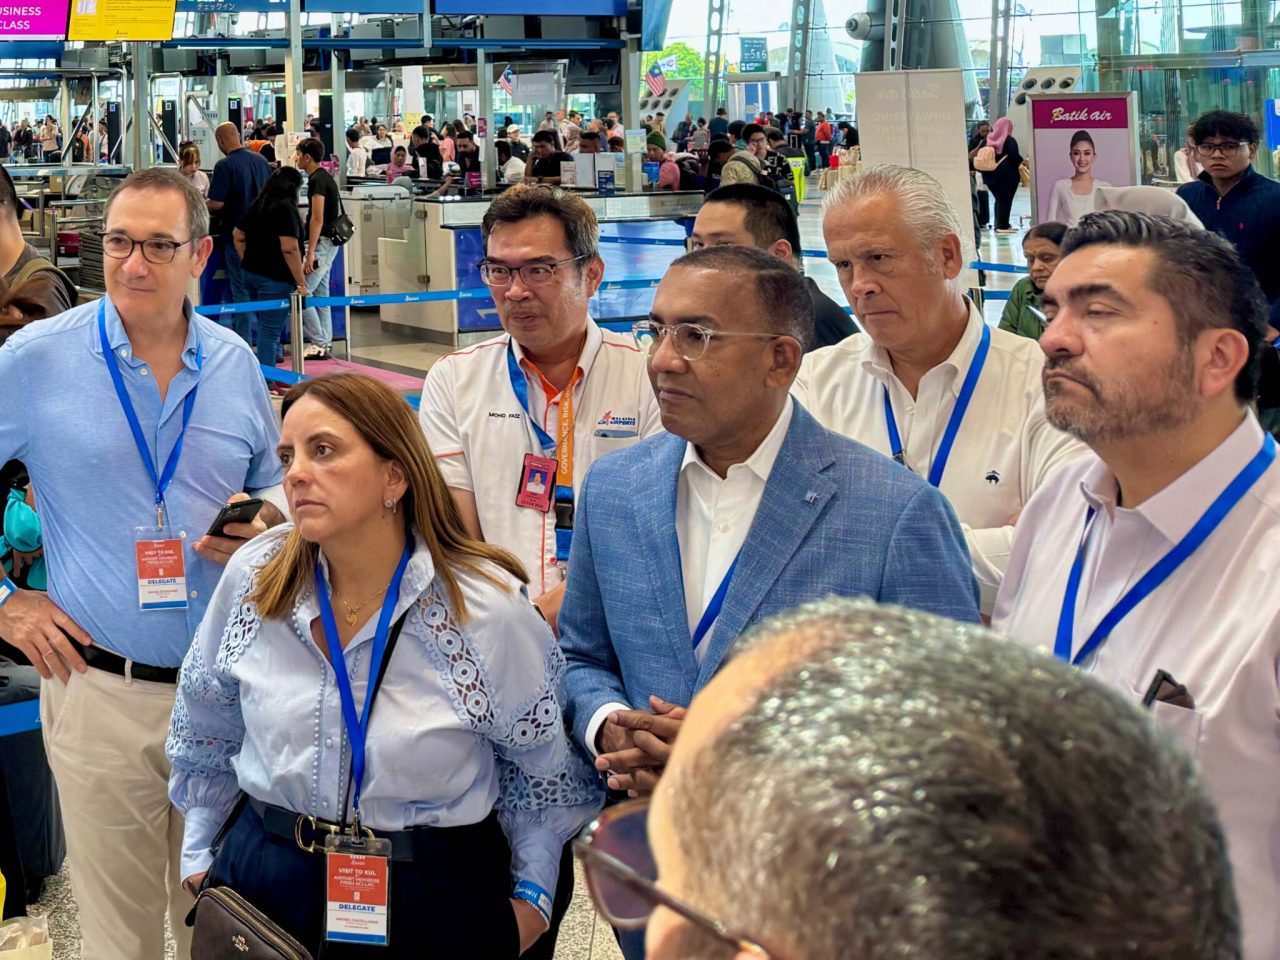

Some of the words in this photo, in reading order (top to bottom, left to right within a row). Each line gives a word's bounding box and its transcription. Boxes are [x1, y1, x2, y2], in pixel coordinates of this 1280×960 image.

[1051, 107, 1088, 123] Batik
[1089, 109, 1112, 122] air
[338, 903, 376, 912] DELEGATE
